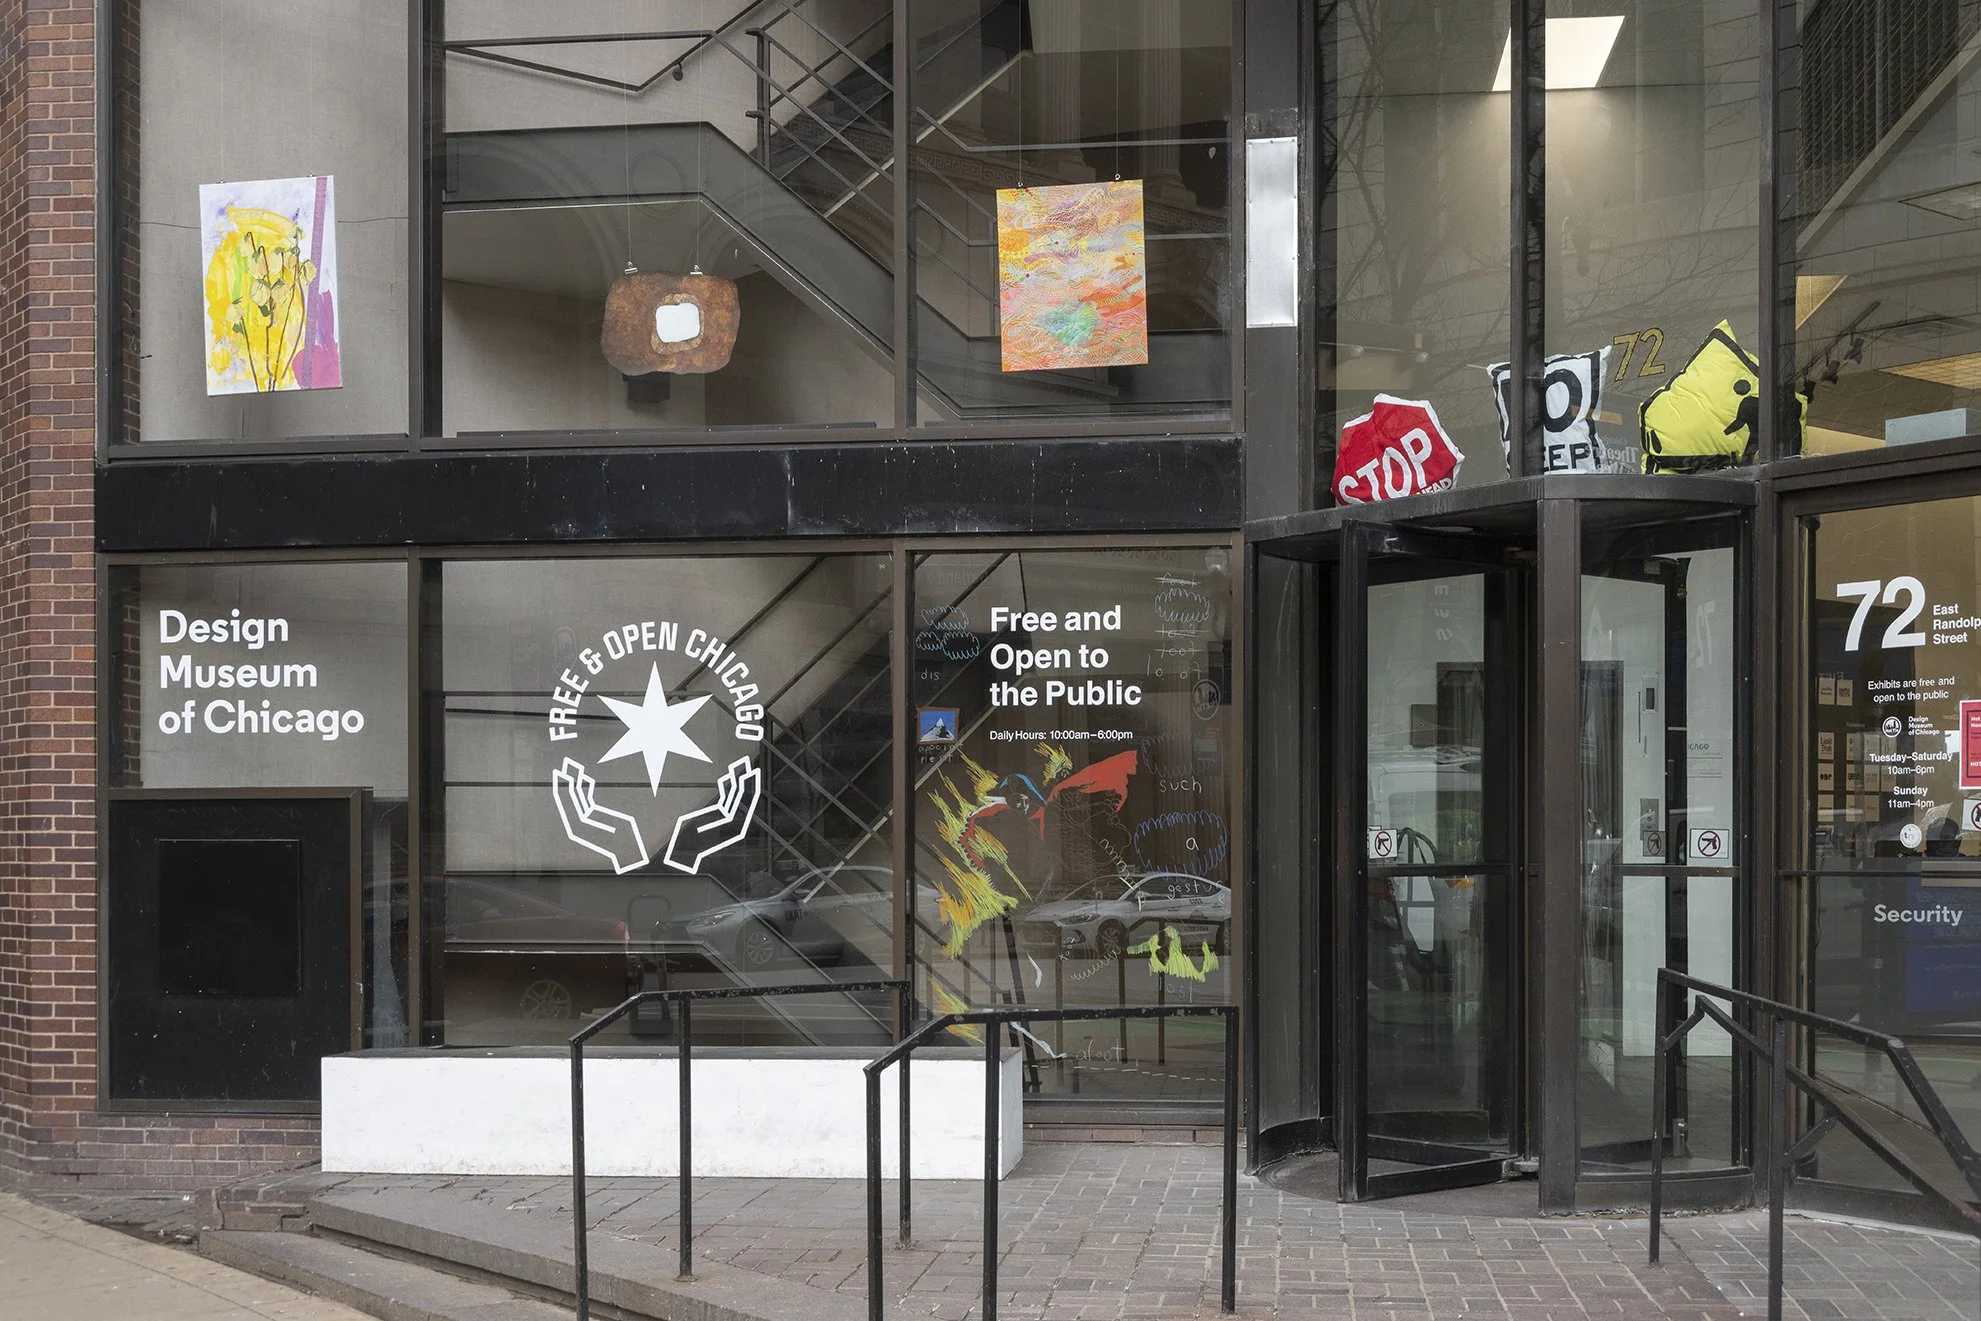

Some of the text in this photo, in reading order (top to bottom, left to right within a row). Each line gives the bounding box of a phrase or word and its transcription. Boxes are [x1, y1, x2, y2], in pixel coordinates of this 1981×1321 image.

[1612, 327, 1666, 382] 72
[1339, 427, 1433, 505] STOP
[990, 604, 1121, 632] Free and
[1836, 576, 1926, 652] 72
[1933, 603, 1959, 616] East
[159, 608, 289, 650] Design
[1933, 616, 1981, 631] Randolp
[1932, 631, 1968, 645] Street
[989, 643, 1109, 676] Open to
[160, 654, 317, 689] Museum
[549, 621, 764, 741] FREE & OPEN CHICAGO
[989, 679, 1142, 707] the Public
[1867, 680, 1901, 691] Exhibits
[1919, 677, 1935, 686] free
[1938, 676, 1955, 685] and
[1873, 690, 1949, 704] open to the public
[158, 699, 365, 741] of Chicago
[1908, 715, 1929, 723] Design
[989, 730, 1015, 742] Daily
[1015, 730, 1047, 741] Hours:
[1915, 728, 1940, 736] Chicago
[1159, 775, 1202, 794] such
[1893, 786, 1928, 797] Sunday
[1185, 837, 1199, 851] a
[1873, 903, 1964, 927] Security
